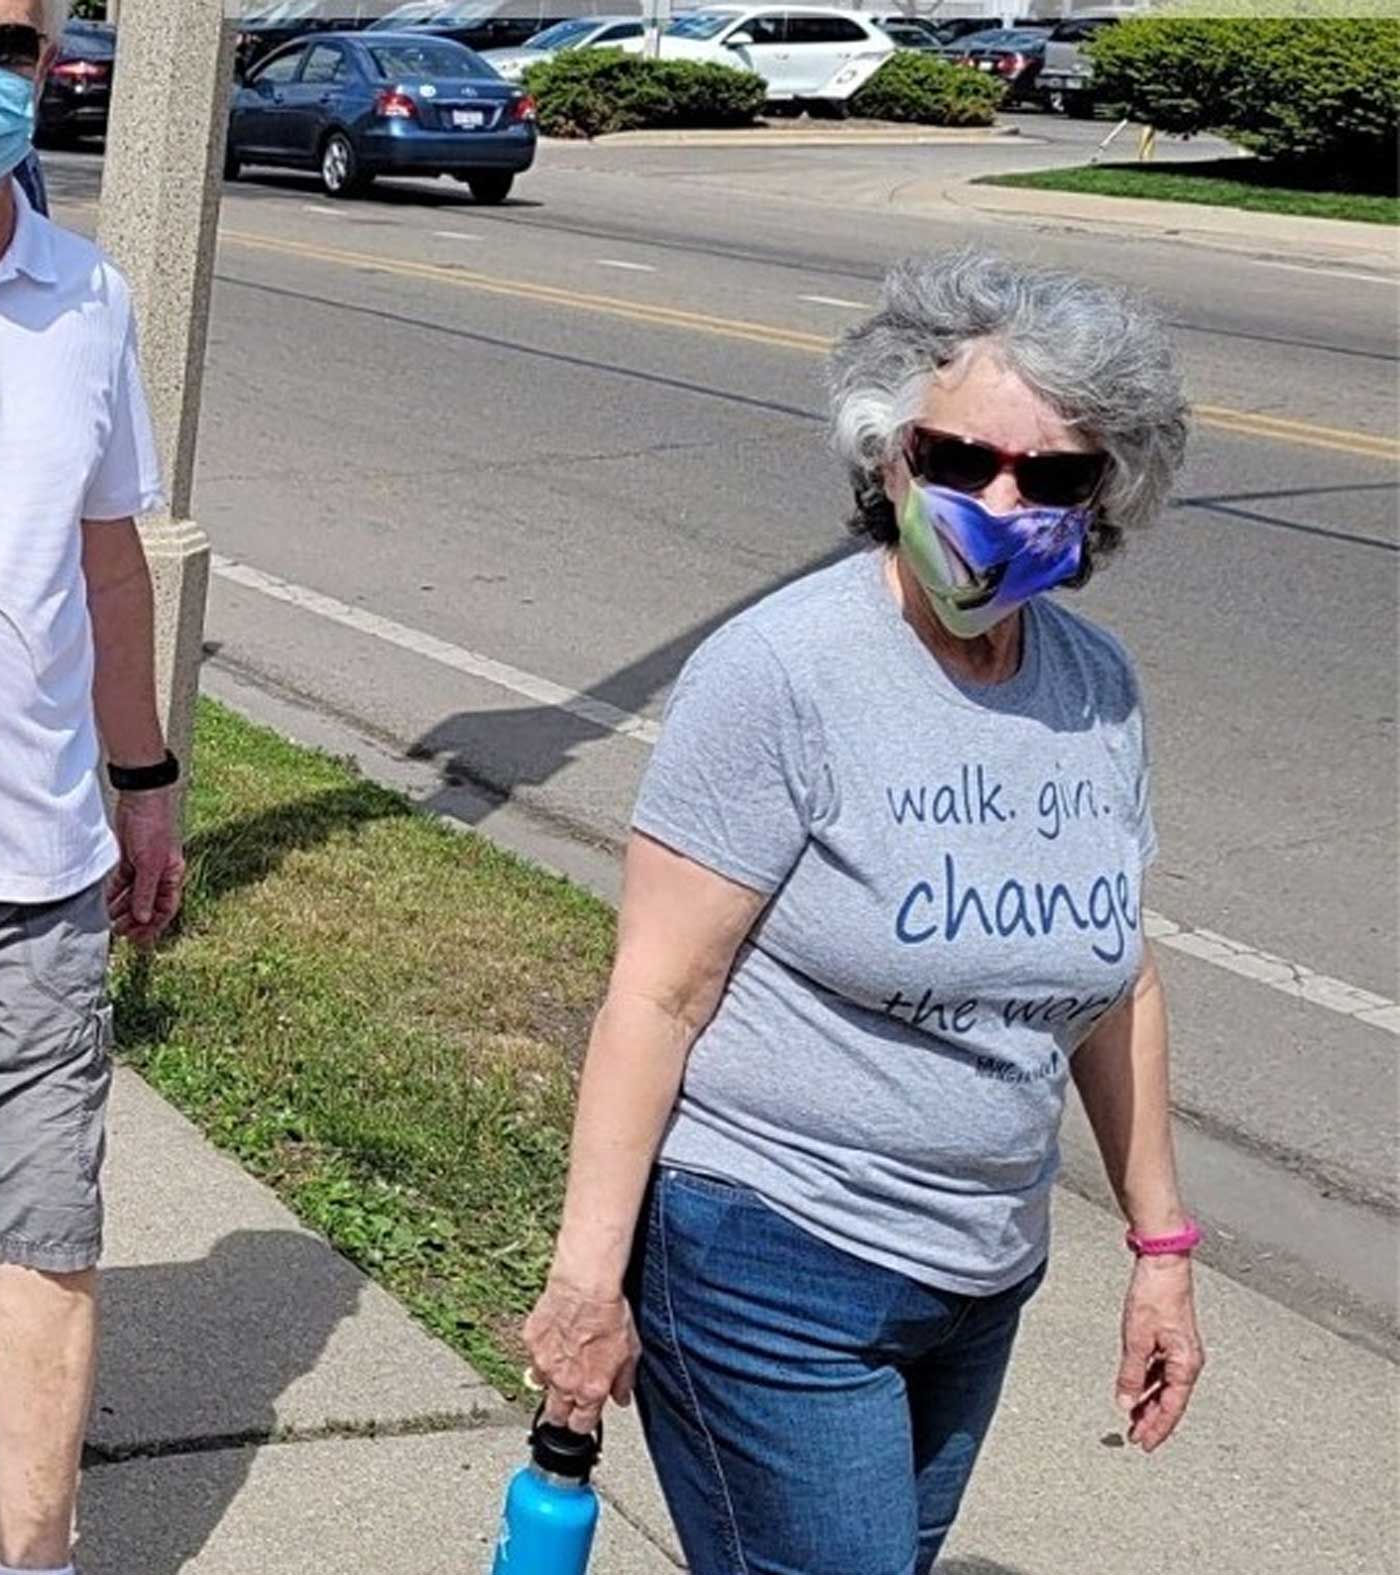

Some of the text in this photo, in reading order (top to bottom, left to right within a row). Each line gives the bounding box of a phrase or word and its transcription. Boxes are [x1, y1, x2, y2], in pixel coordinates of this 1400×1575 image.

[887, 764, 1016, 824] walk.
[896, 853, 1137, 964] change
[883, 989, 978, 1032] the
